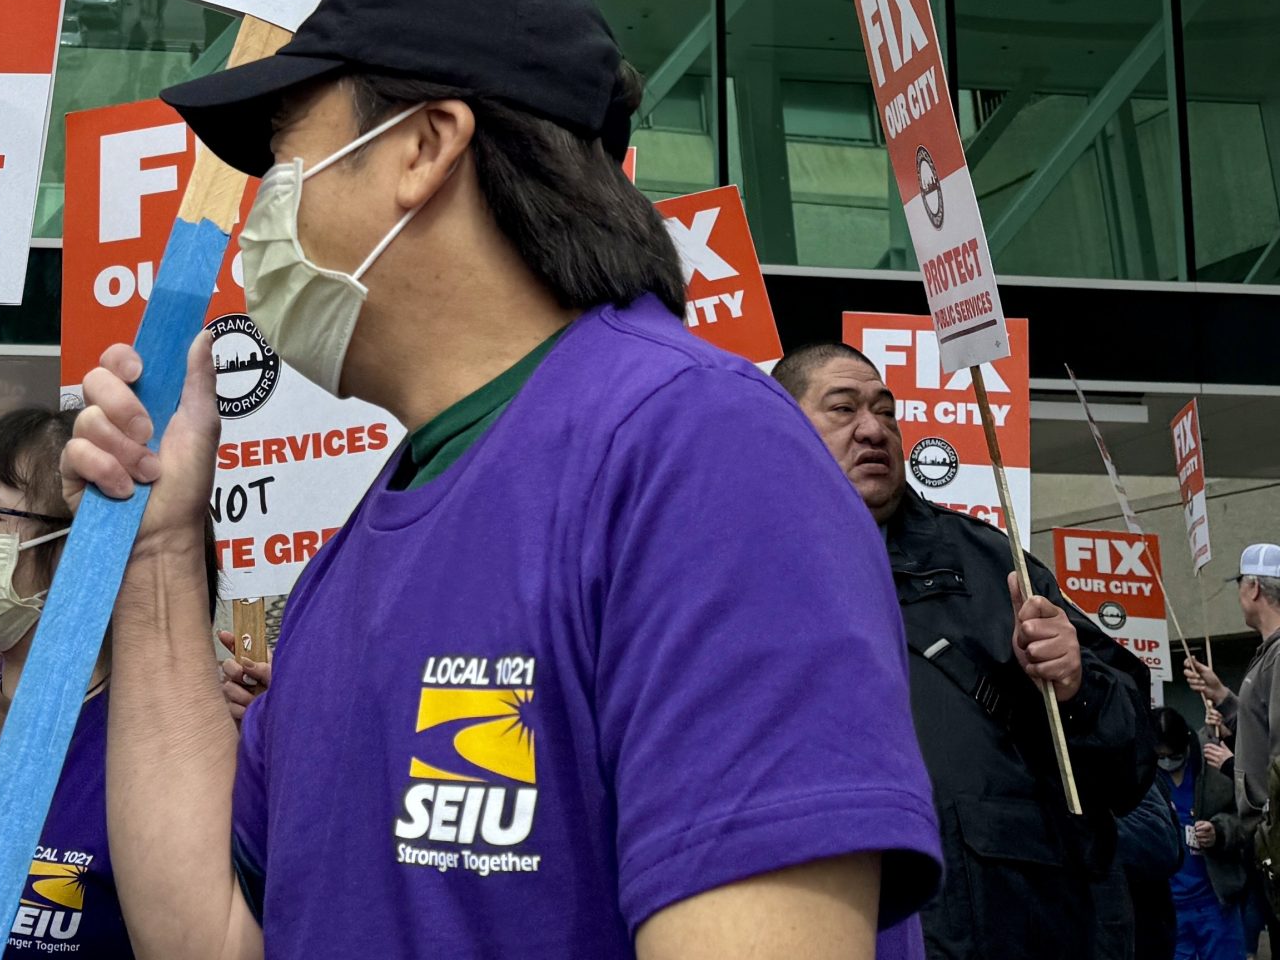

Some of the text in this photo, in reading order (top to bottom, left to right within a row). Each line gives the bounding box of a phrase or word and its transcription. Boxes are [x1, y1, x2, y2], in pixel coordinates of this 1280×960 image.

[885, 66, 939, 139] OUR CITY
[923, 237, 981, 297] PROTECT
[685, 290, 744, 327] ITY
[935, 292, 993, 331] PUBLIC SERVICES
[220, 370, 275, 412] WORKERS
[895, 400, 1011, 426] UR CITY
[218, 424, 388, 470] SERVICES
[912, 439, 957, 462] SAN FRANCISCO
[1173, 410, 1196, 464] FIX
[912, 466, 956, 486] CITY WORKERS
[1064, 537, 1152, 577] FIX
[1066, 577, 1152, 596] OUR CITY
[1134, 639, 1160, 652] UP
[422, 657, 535, 685] LOCAL 1021
[395, 784, 538, 846] SEIU
[32, 846, 93, 866] CAL 1021
[398, 843, 541, 876] Stronger Together
[11, 907, 82, 940] EIU
[36, 939, 80, 953] Together
